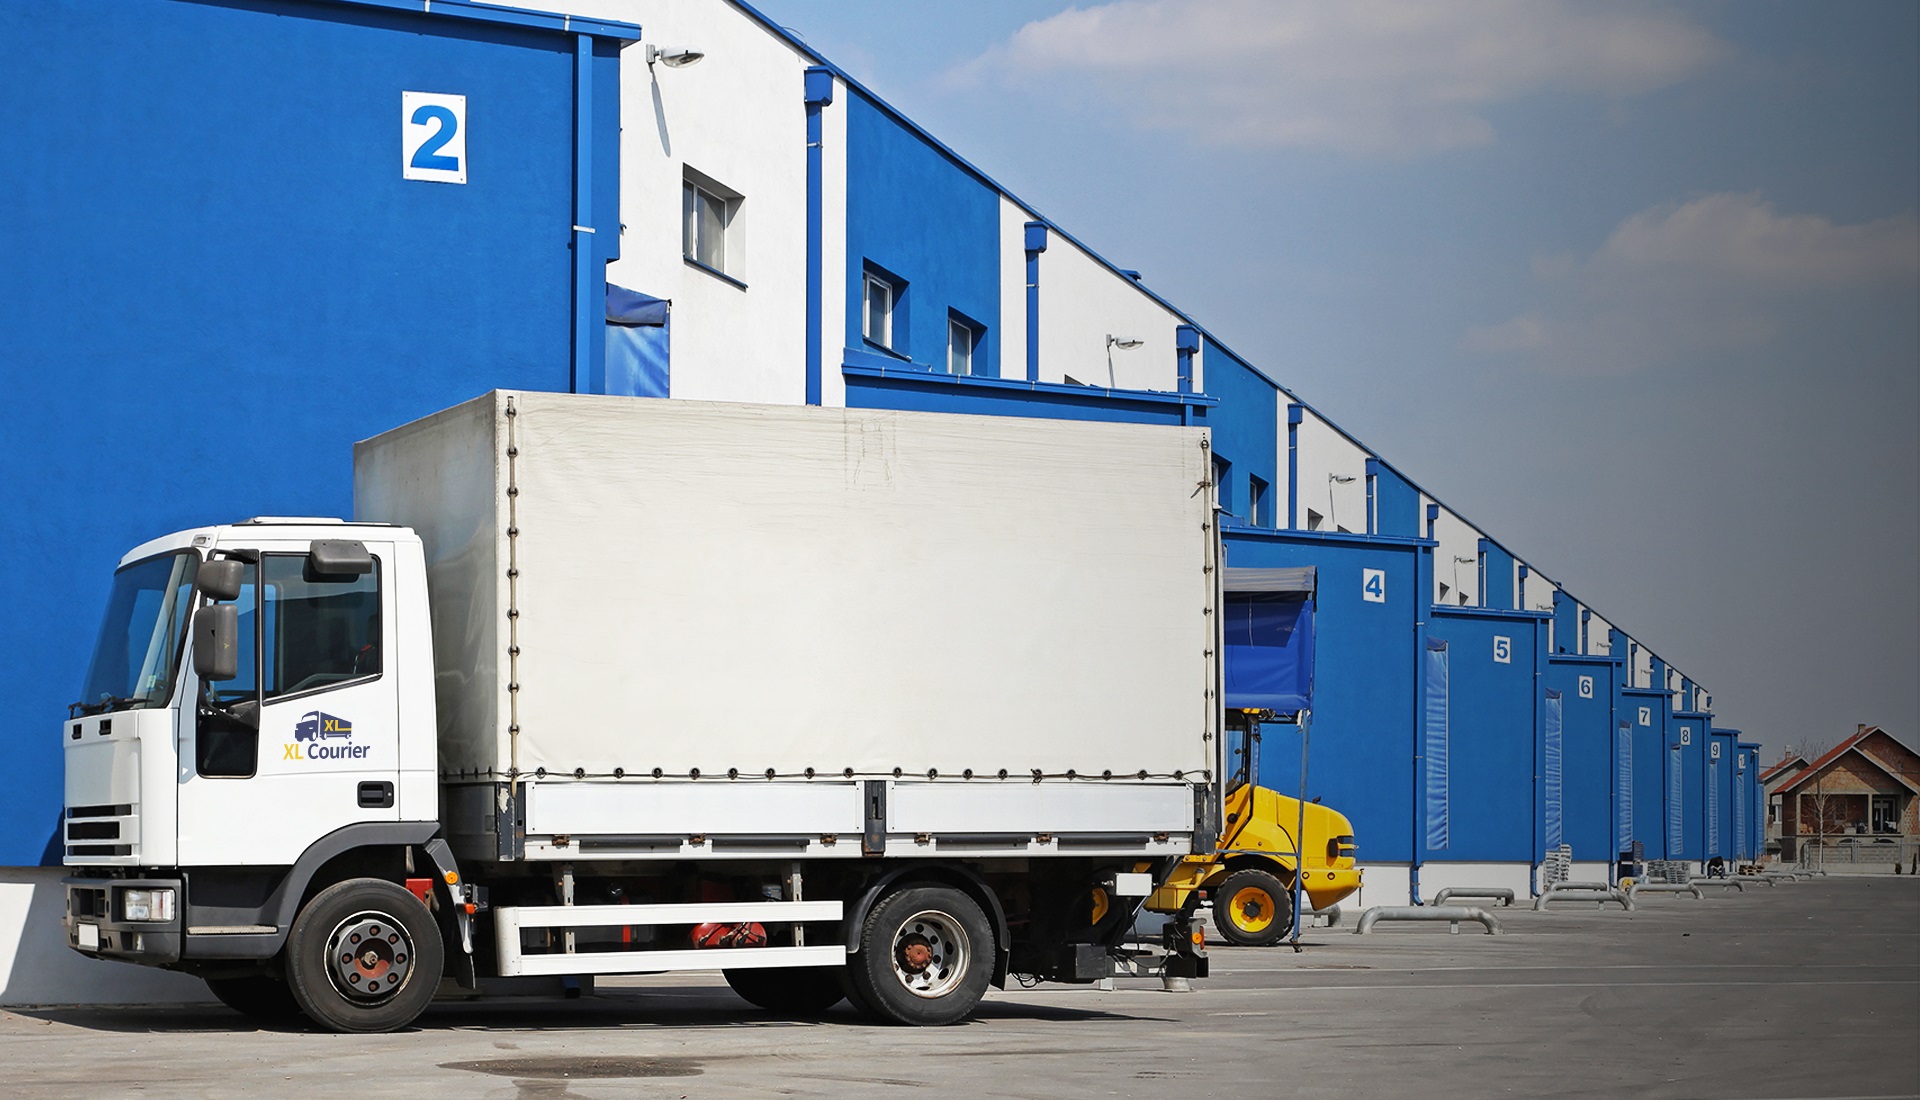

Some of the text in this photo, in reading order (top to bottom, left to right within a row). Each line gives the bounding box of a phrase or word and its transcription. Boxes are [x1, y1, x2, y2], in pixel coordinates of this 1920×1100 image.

[410, 105, 459, 172] 2
[1365, 574, 1382, 598] 4
[1496, 640, 1508, 659] 5
[1581, 679, 1591, 695] 6
[1640, 709, 1648, 723] 7
[324, 720, 352, 732] XL
[1682, 729, 1689, 743] 8
[283, 741, 371, 760] XL Courier
[1712, 744, 1718, 756] 9
